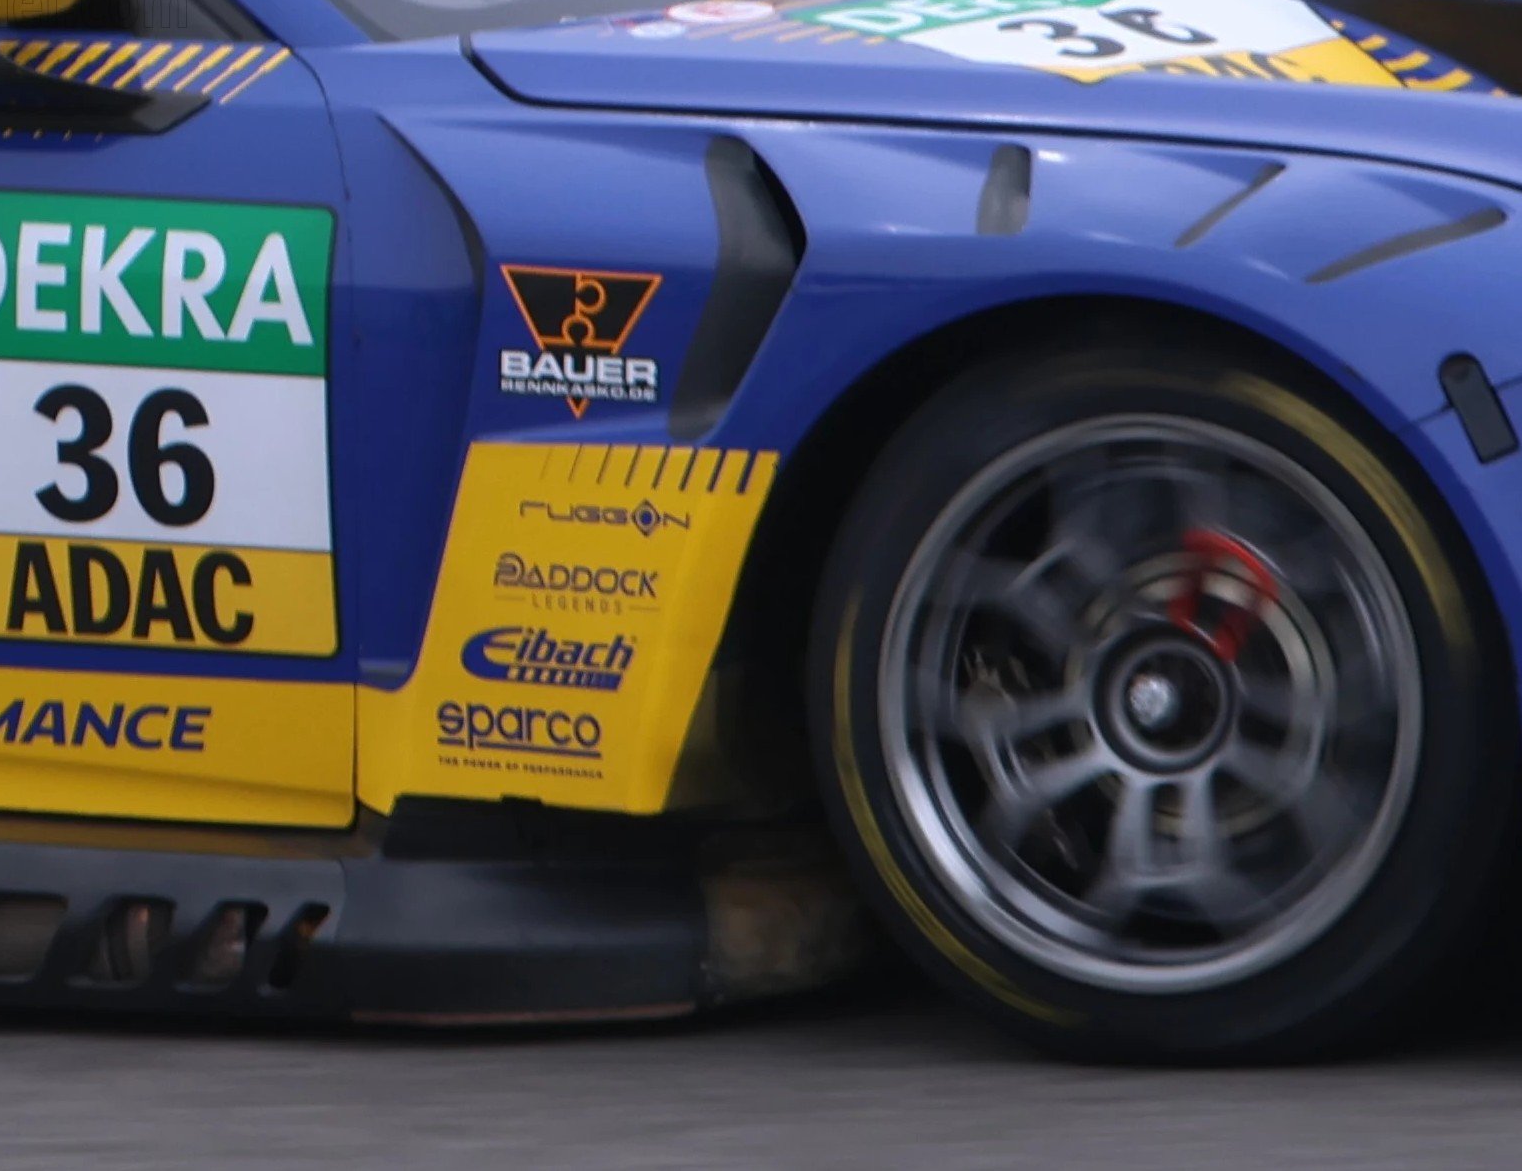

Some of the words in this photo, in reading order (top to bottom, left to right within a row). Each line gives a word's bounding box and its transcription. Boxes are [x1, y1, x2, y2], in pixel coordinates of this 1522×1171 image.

[500, 350, 657, 387] BAUER
[33, 383, 216, 527] 36
[5, 541, 254, 645] ADAC
[493, 552, 659, 598] PADDOCK
[532, 594, 622, 615] LEGENDS
[461, 626, 635, 690] Eibach
[438, 699, 602, 751] sparco
